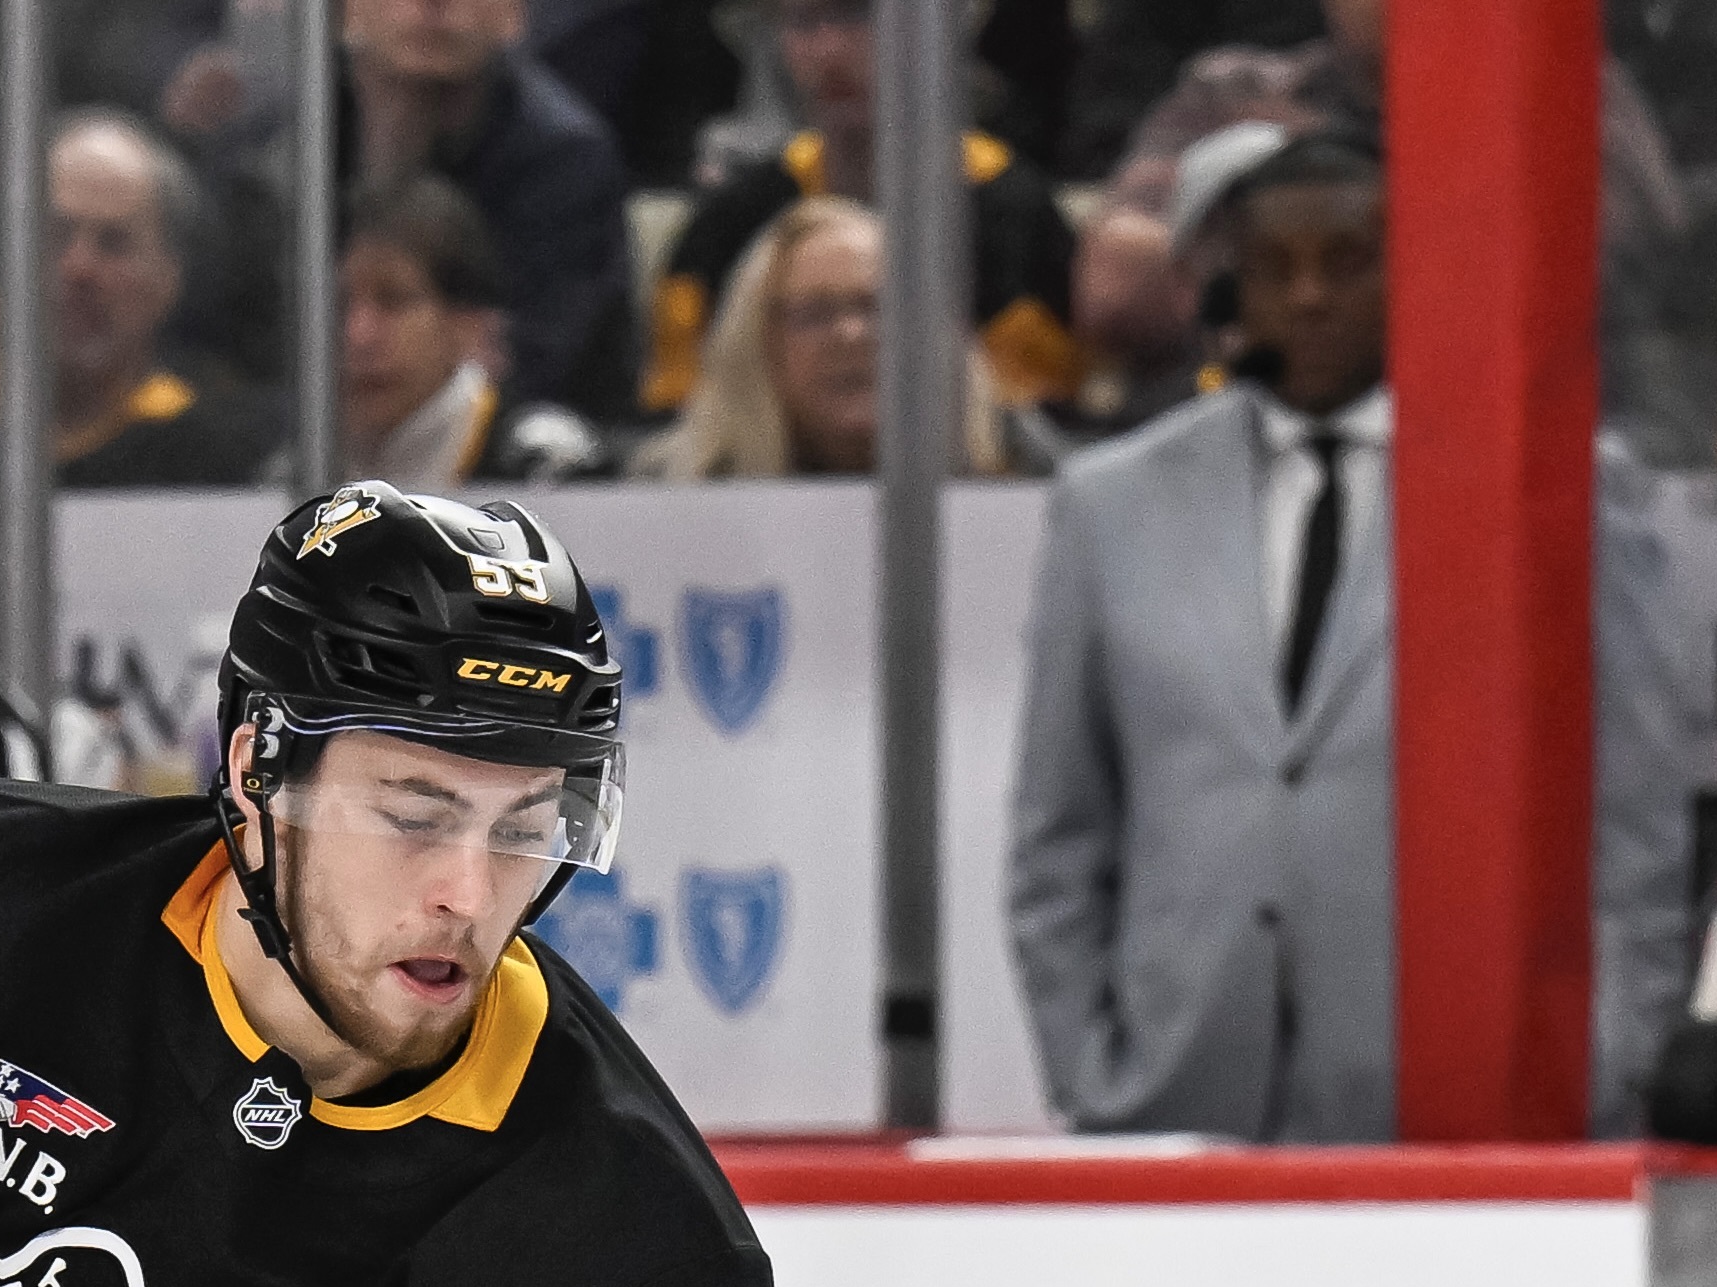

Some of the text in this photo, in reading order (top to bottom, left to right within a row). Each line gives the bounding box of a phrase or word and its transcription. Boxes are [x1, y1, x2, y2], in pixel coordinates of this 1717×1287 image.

[468, 553, 552, 605] 59
[457, 657, 572, 693] CCM
[242, 1108, 287, 1123] NHL
